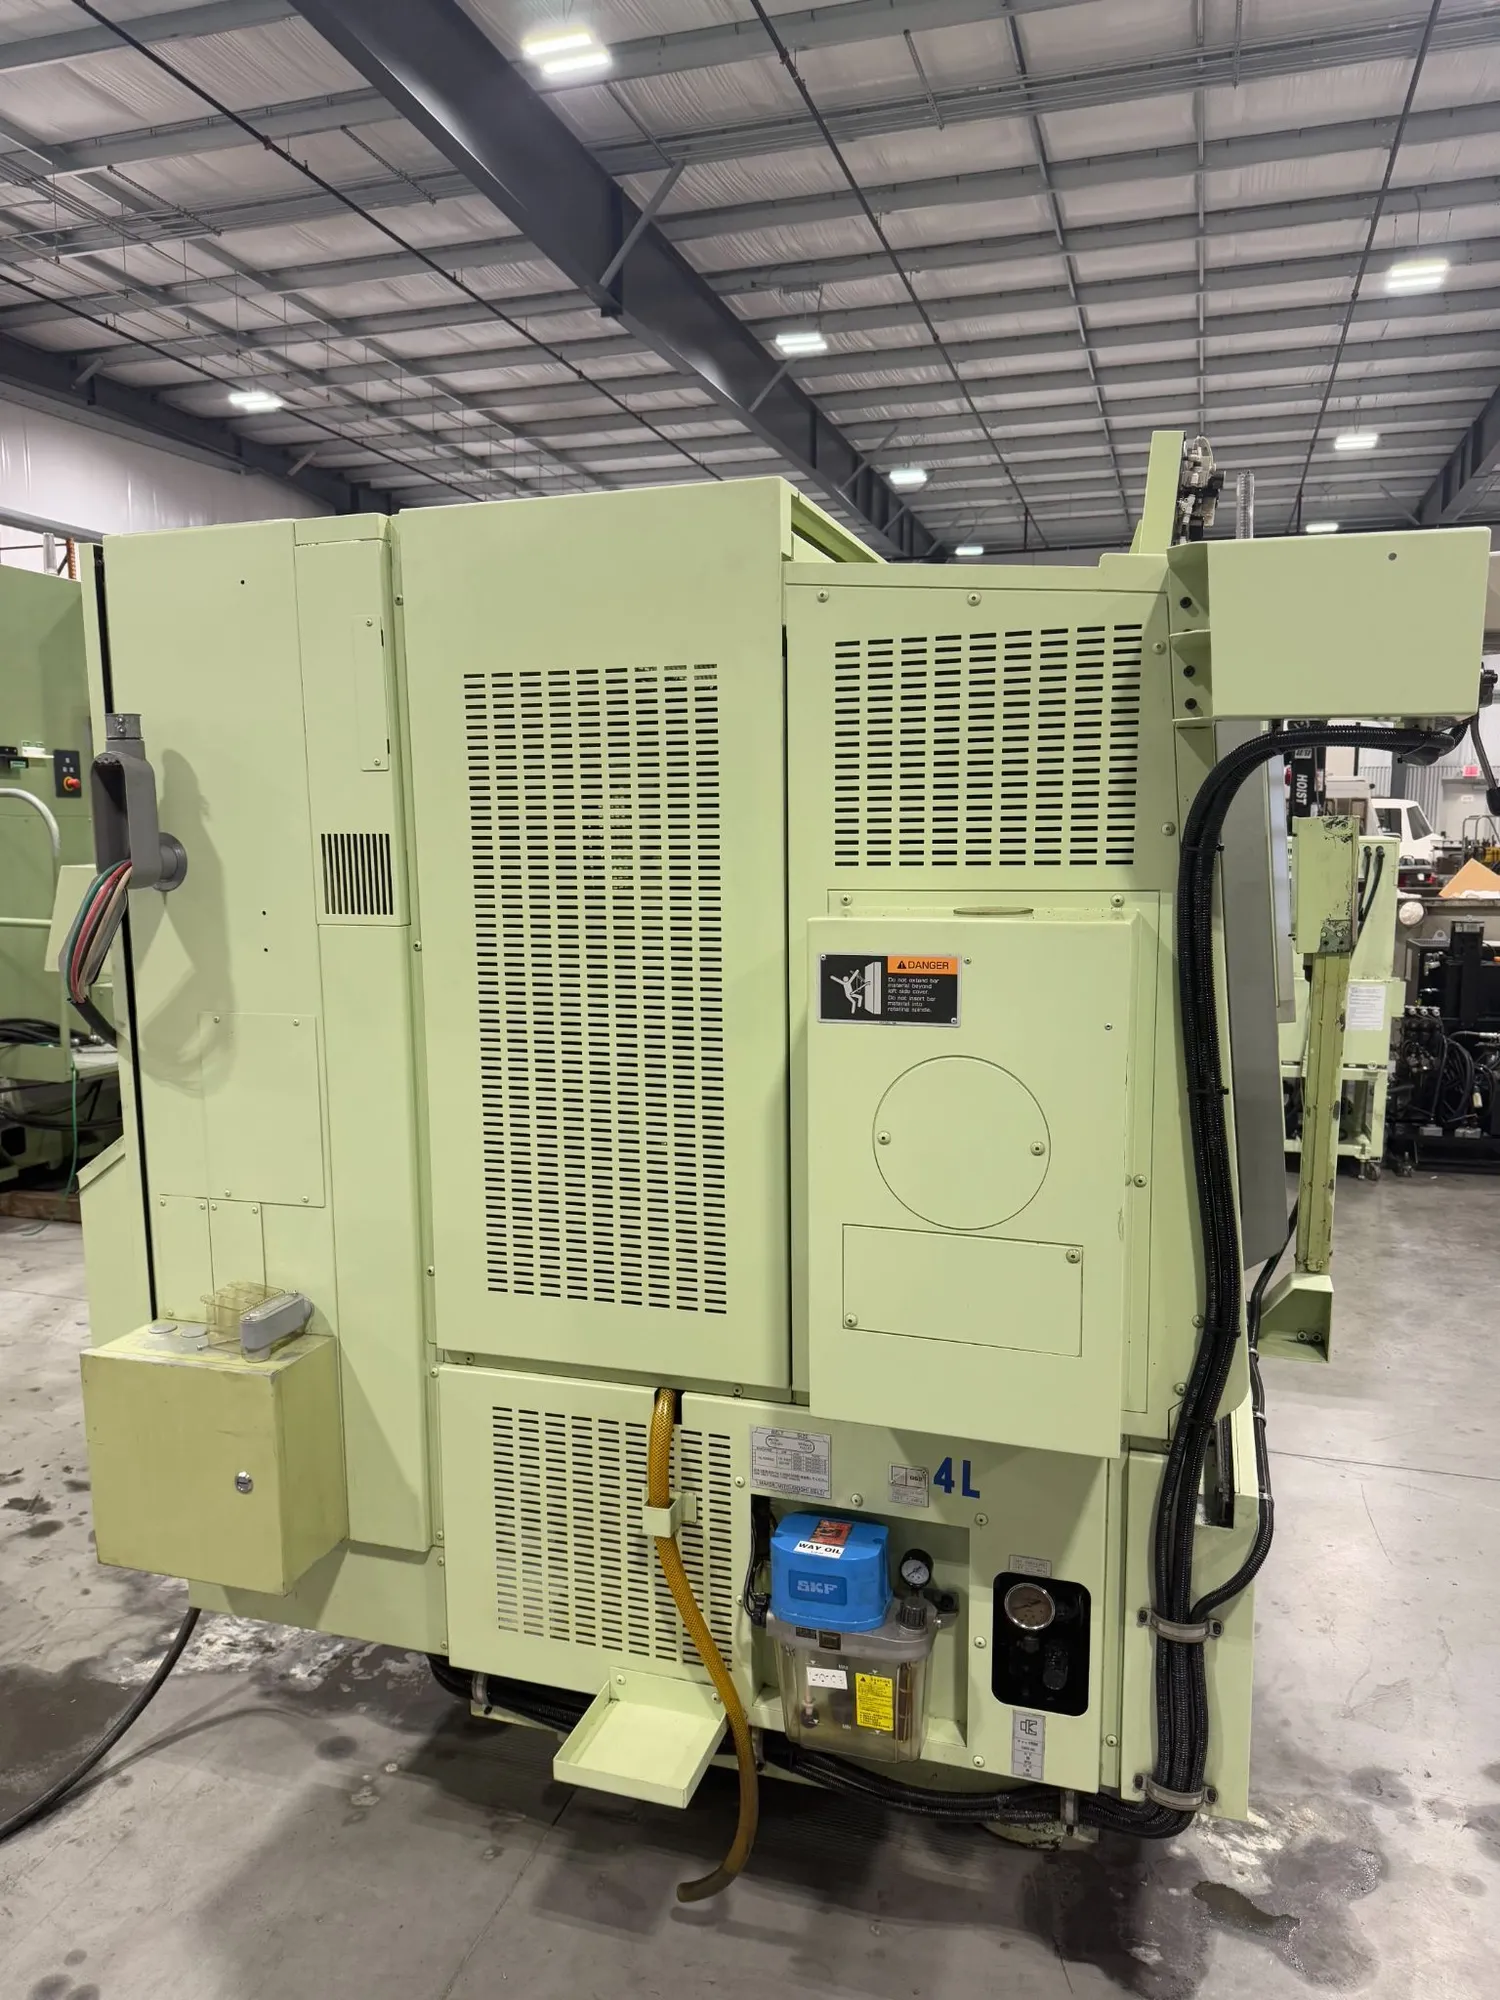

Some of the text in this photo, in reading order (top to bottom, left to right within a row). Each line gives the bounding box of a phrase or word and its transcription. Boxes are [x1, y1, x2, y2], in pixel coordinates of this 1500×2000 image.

[1296, 774, 1308, 805] HOIST
[908, 960, 949, 970] DANGER
[933, 1456, 980, 1499] 4L
[798, 1542, 822, 1551] WAY
[824, 1547, 842, 1555] OIL
[797, 1580, 838, 1594] SKF
